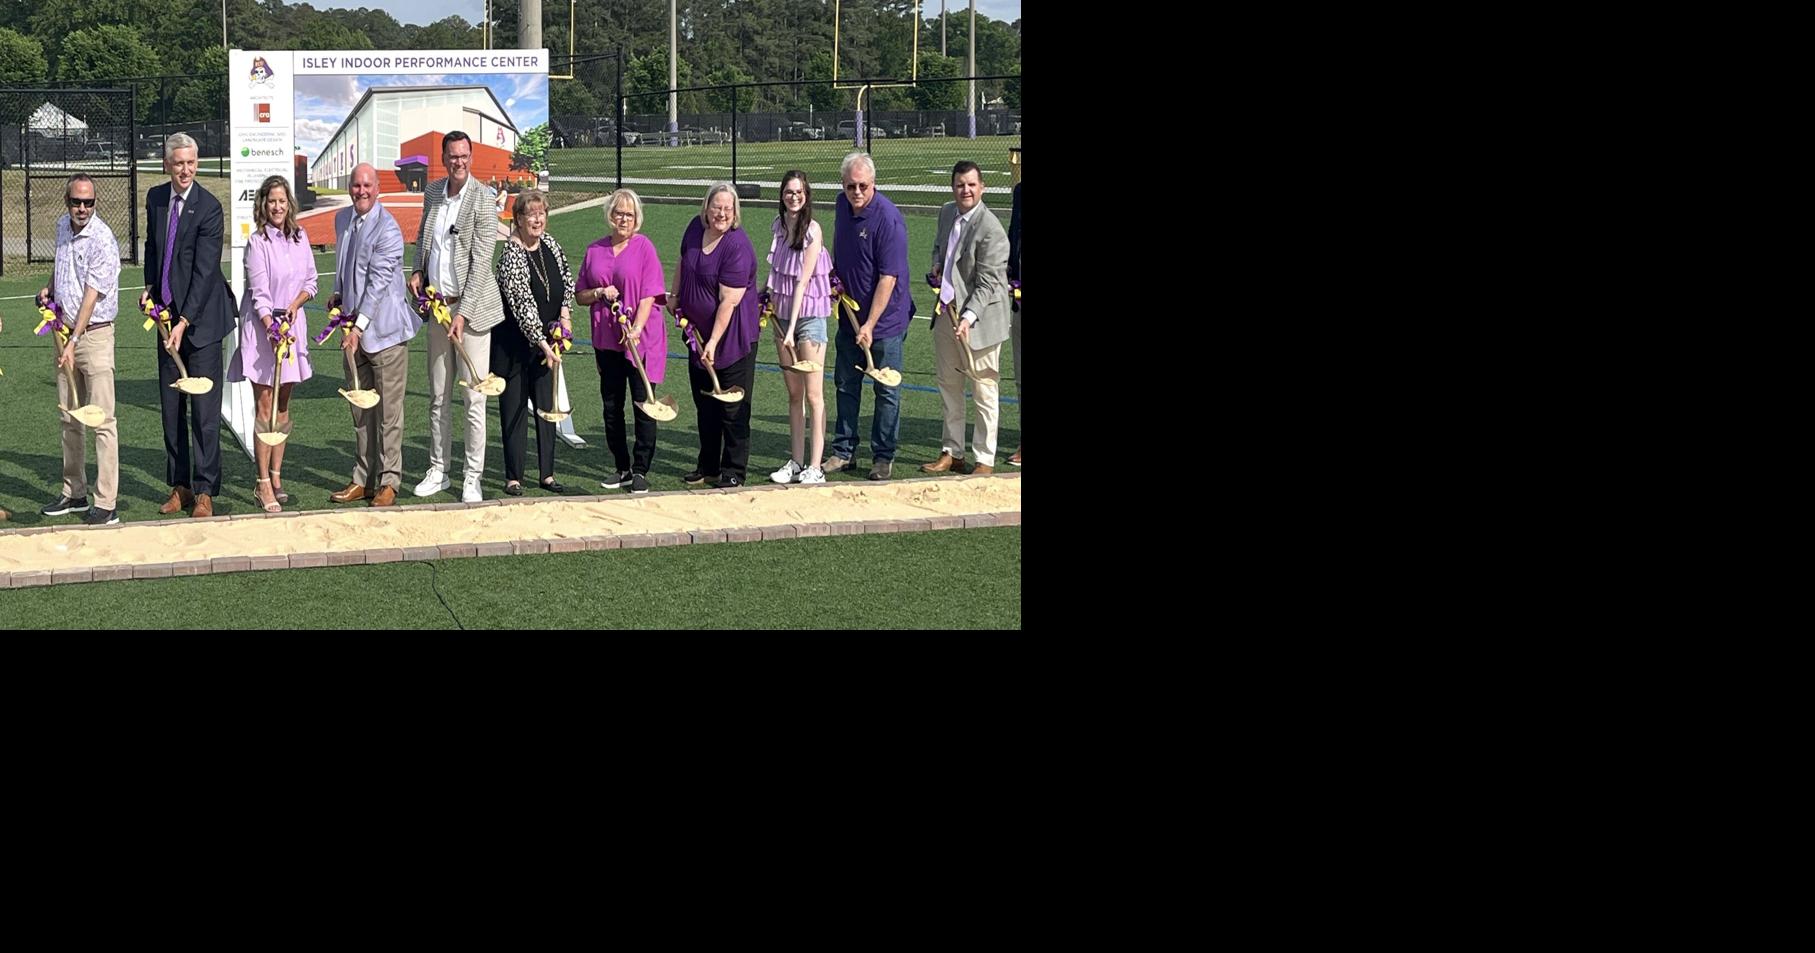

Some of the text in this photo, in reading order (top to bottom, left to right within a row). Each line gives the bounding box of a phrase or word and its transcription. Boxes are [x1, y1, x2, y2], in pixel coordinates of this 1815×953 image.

[303, 56, 538, 68] ISLEY INDOOR PERFORMANCE CENTER
[251, 147, 284, 156] benesch
[238, 190, 255, 201] AE
